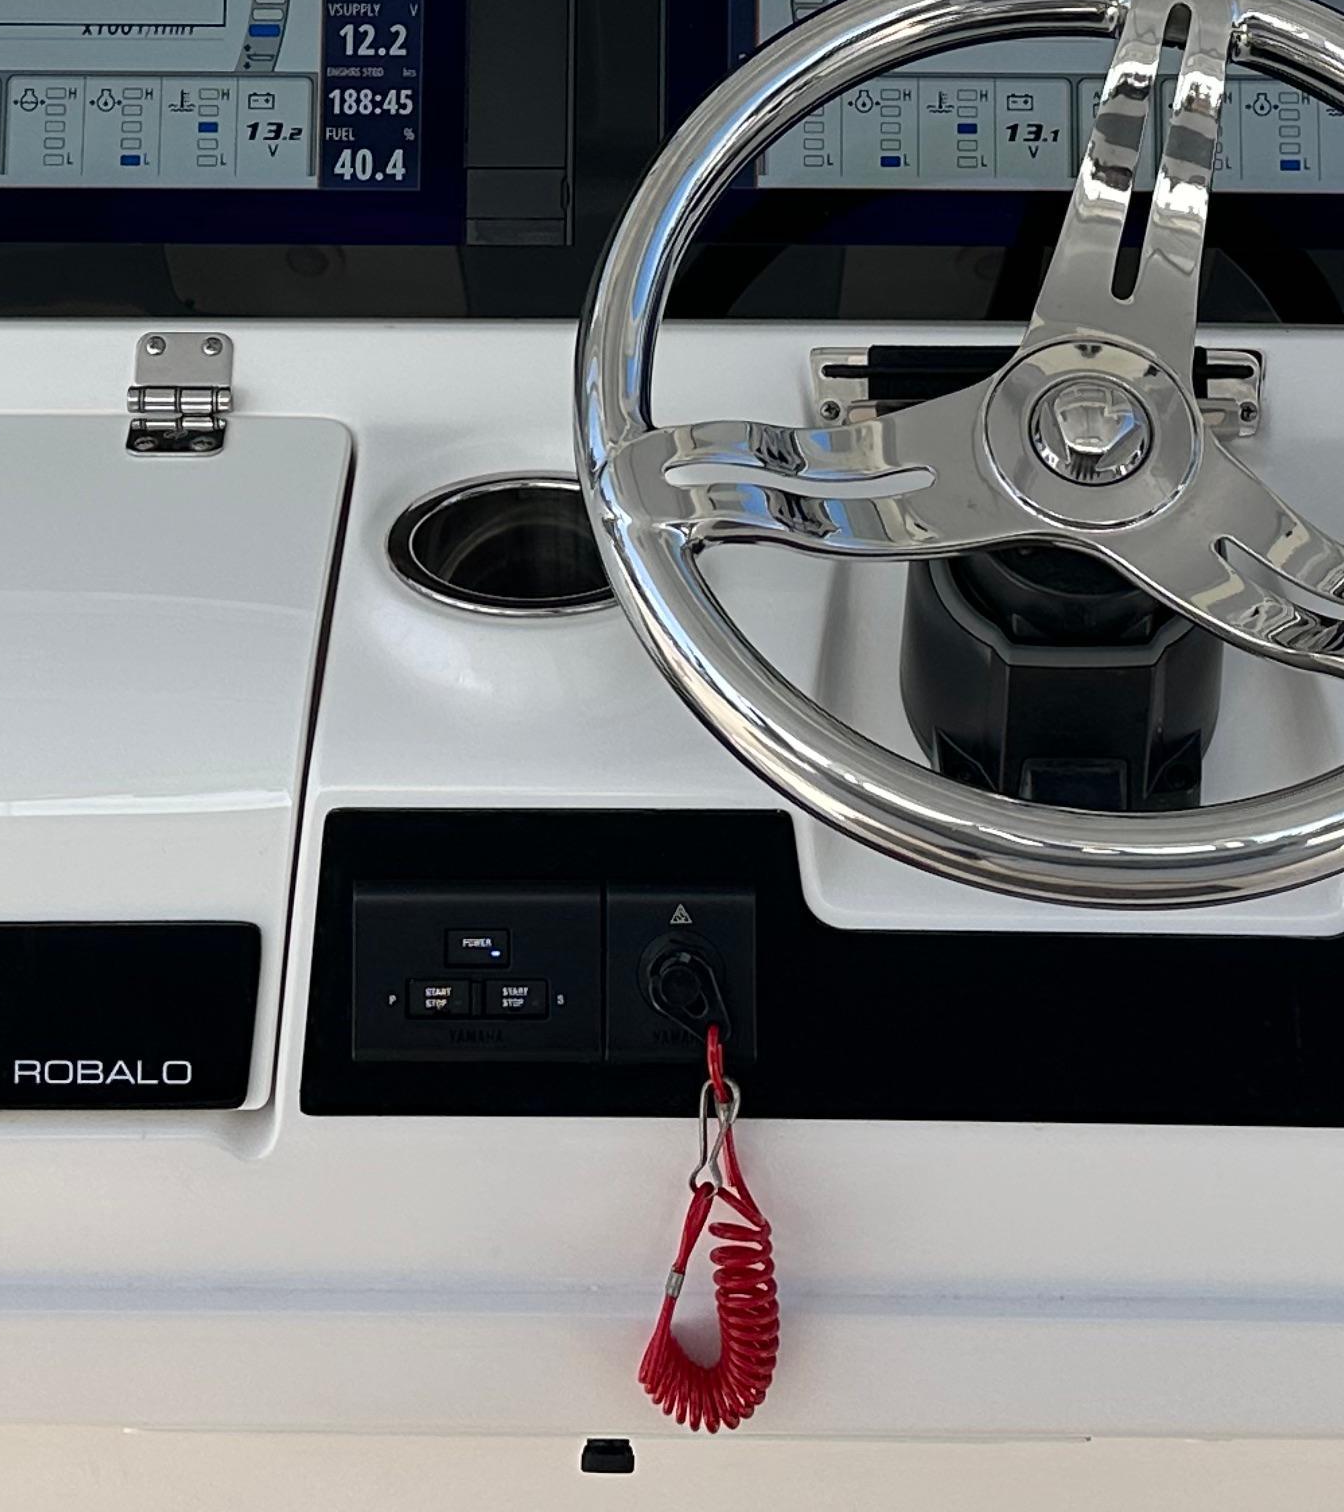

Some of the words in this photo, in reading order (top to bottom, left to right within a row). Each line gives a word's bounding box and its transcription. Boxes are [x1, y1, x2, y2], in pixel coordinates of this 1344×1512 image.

[328, 3, 381, 19] VSUPPLY
[409, 5, 418, 17] V
[339, 24, 407, 56] 12.2
[328, 89, 413, 116] 188:45
[246, 122, 304, 141] 13.2
[326, 128, 354, 140] FUEL
[403, 128, 415, 140] %
[1005, 124, 1060, 143] 13.1
[268, 145, 277, 157] V
[1028, 146, 1039, 158] V
[334, 148, 406, 181] 40.4
[462, 938, 492, 947] POWER
[425, 987, 451, 997] START
[502, 986, 528, 996] START
[449, 1029, 503, 1044] YAMAHA
[14, 1060, 193, 1085] ROBALO
